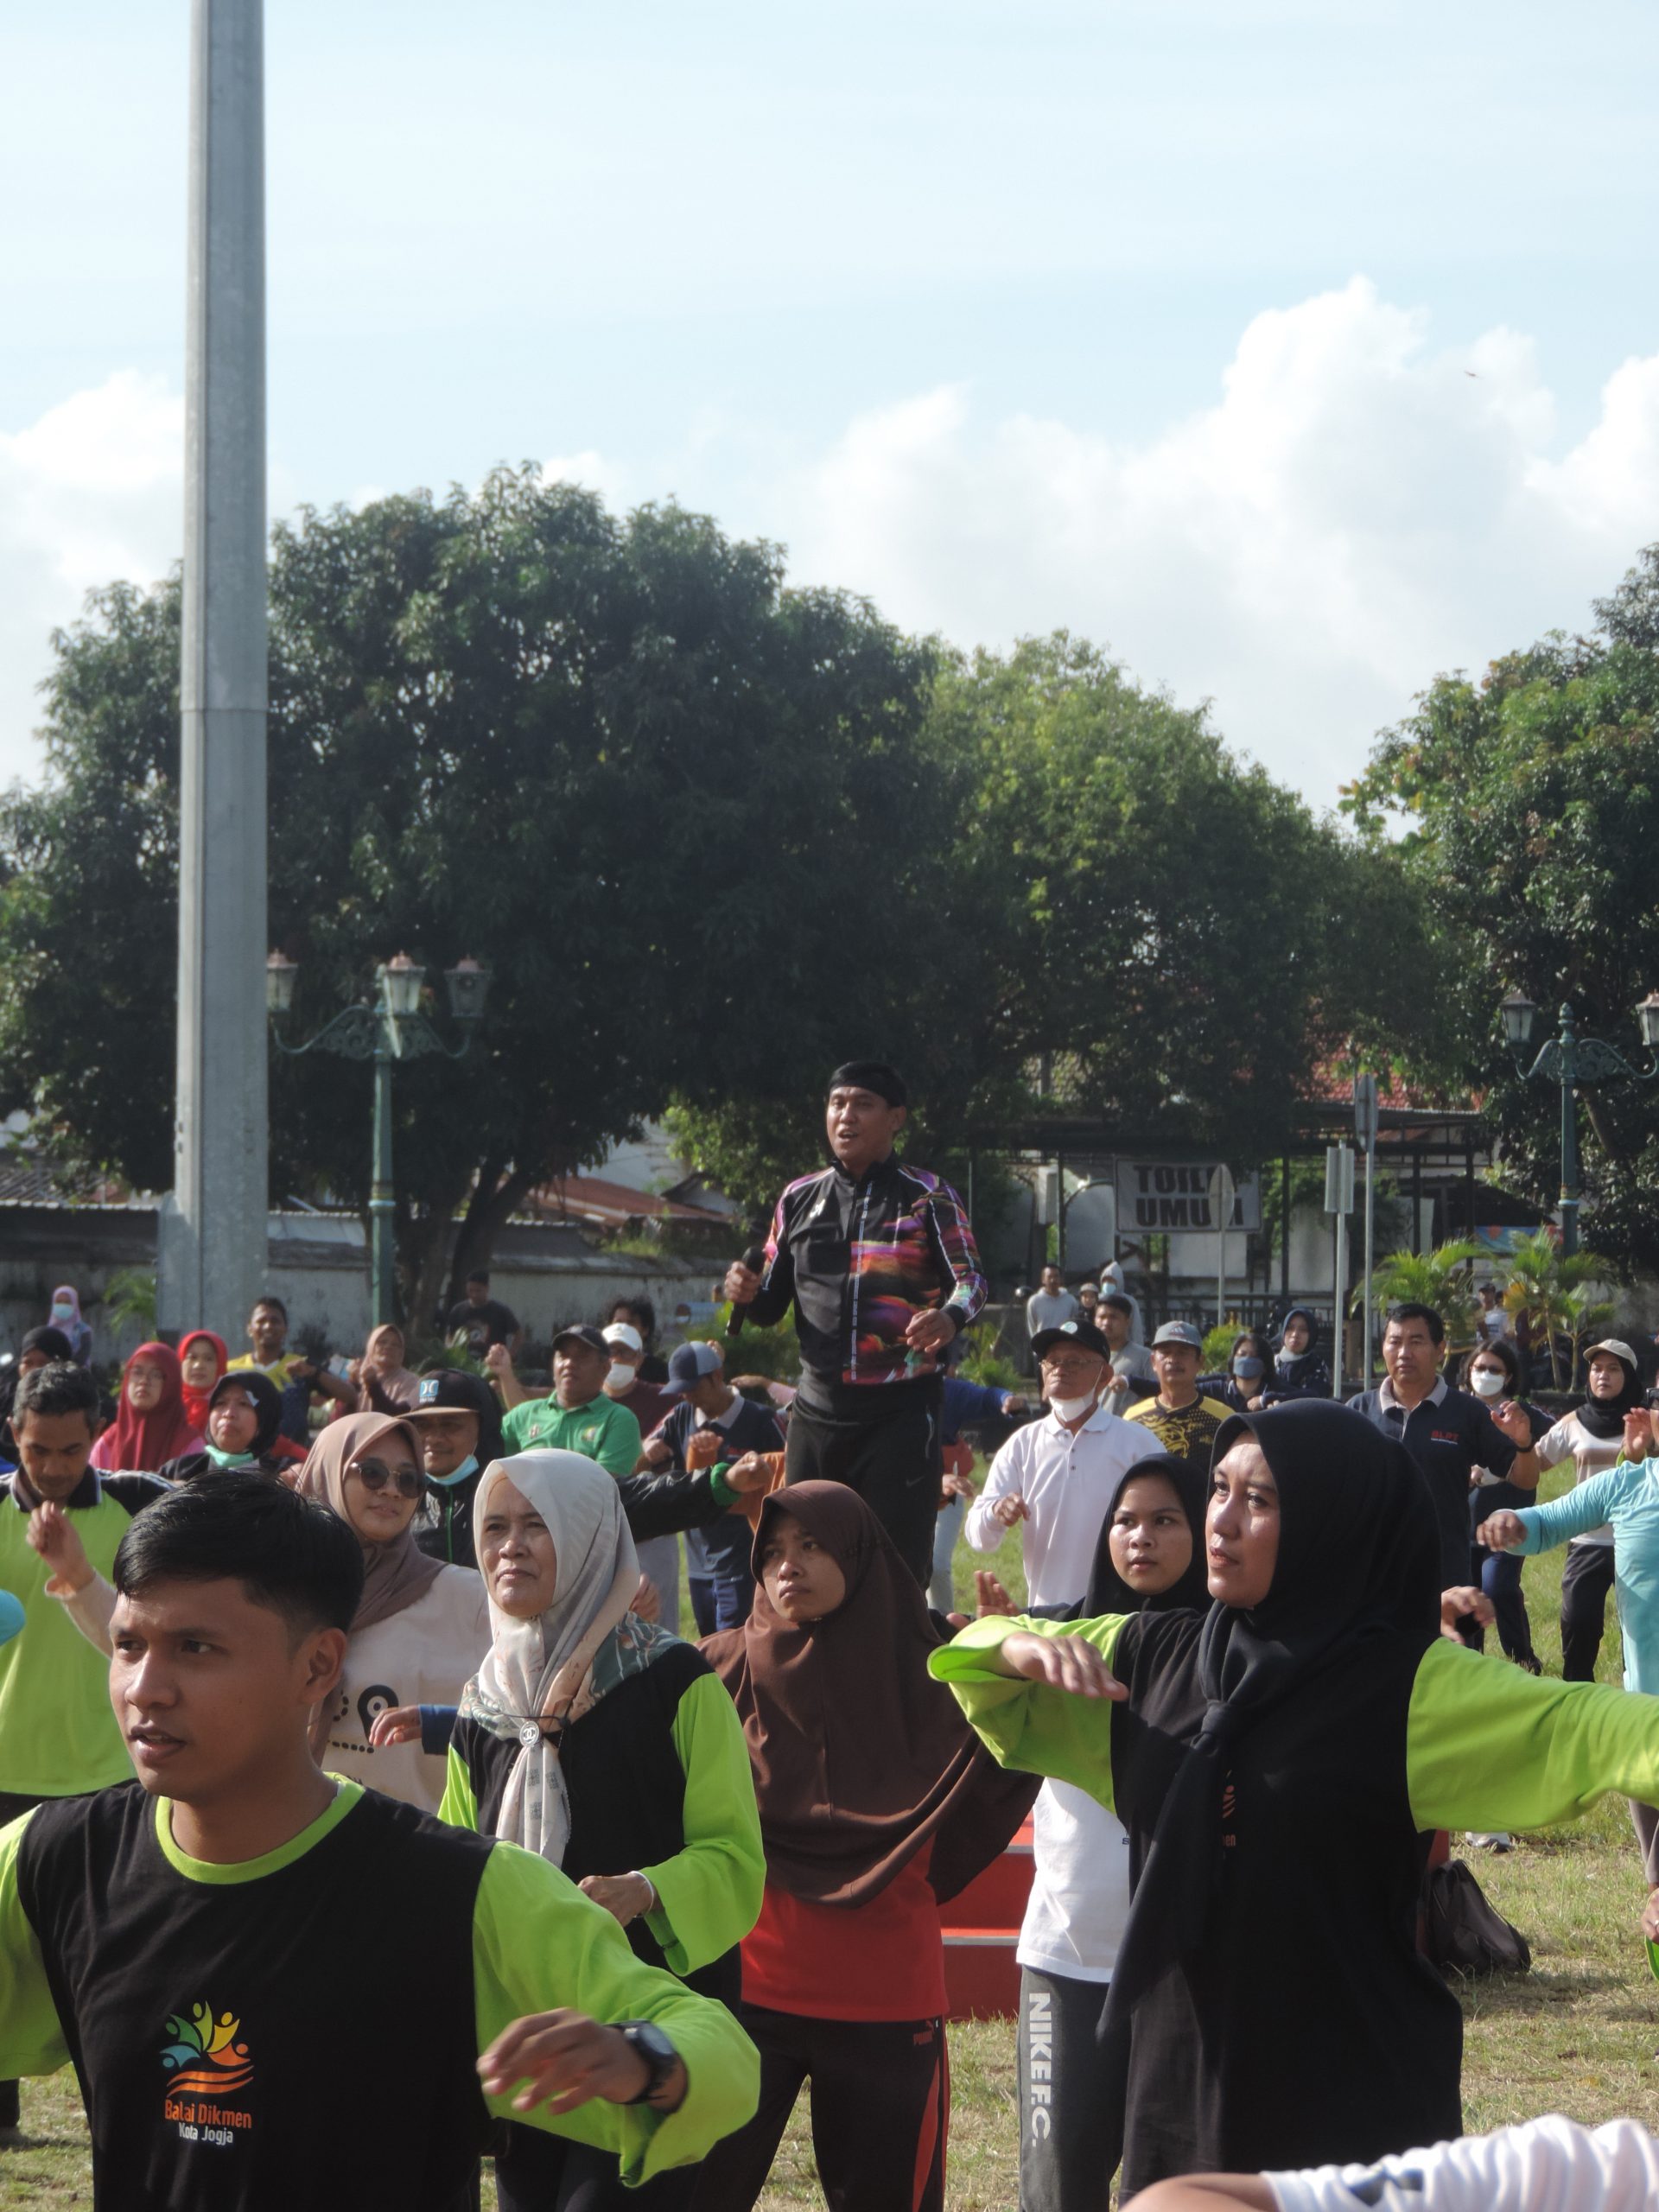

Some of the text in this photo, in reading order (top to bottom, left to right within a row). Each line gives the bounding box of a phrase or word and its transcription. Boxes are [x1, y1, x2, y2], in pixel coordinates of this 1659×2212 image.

[1028, 1992, 1052, 2080] NIKE
[164, 2099, 252, 2129] Balai Dikmen
[178, 2121, 233, 2146] Kota Jogja
